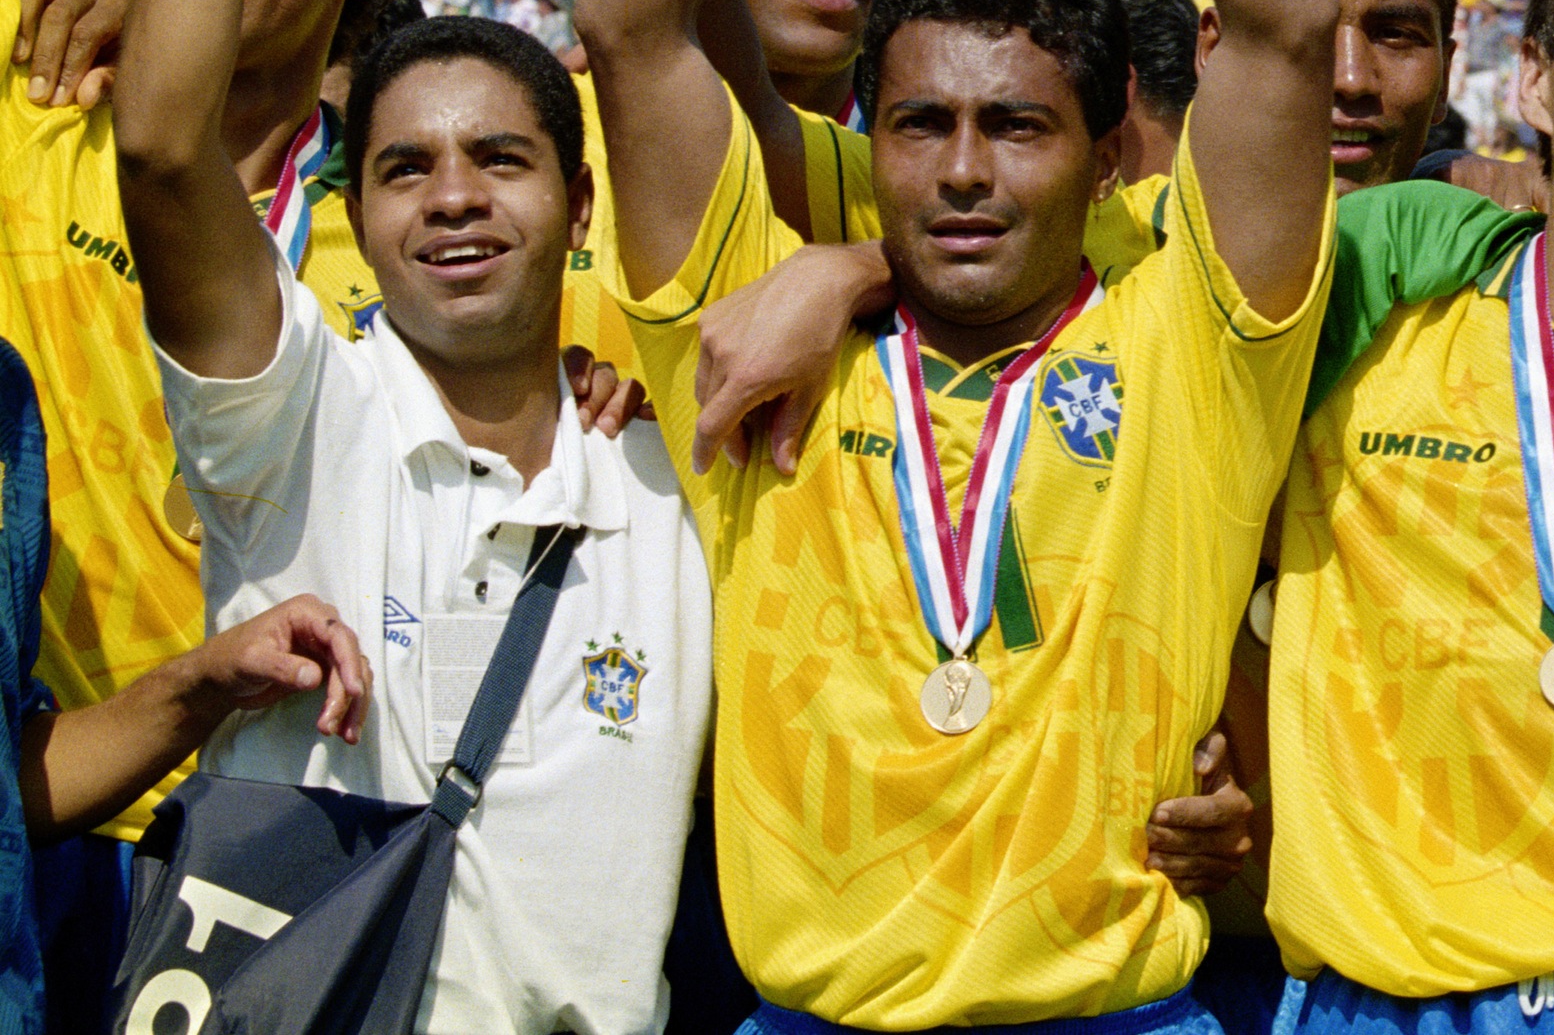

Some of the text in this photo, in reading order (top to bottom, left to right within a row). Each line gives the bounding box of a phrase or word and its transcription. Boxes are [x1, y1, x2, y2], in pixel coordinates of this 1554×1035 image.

[1069, 394, 1103, 418] CBF
[1359, 431, 1497, 464] UMBRO
[1379, 618, 1497, 672] CBF
[600, 679, 625, 695] CBF
